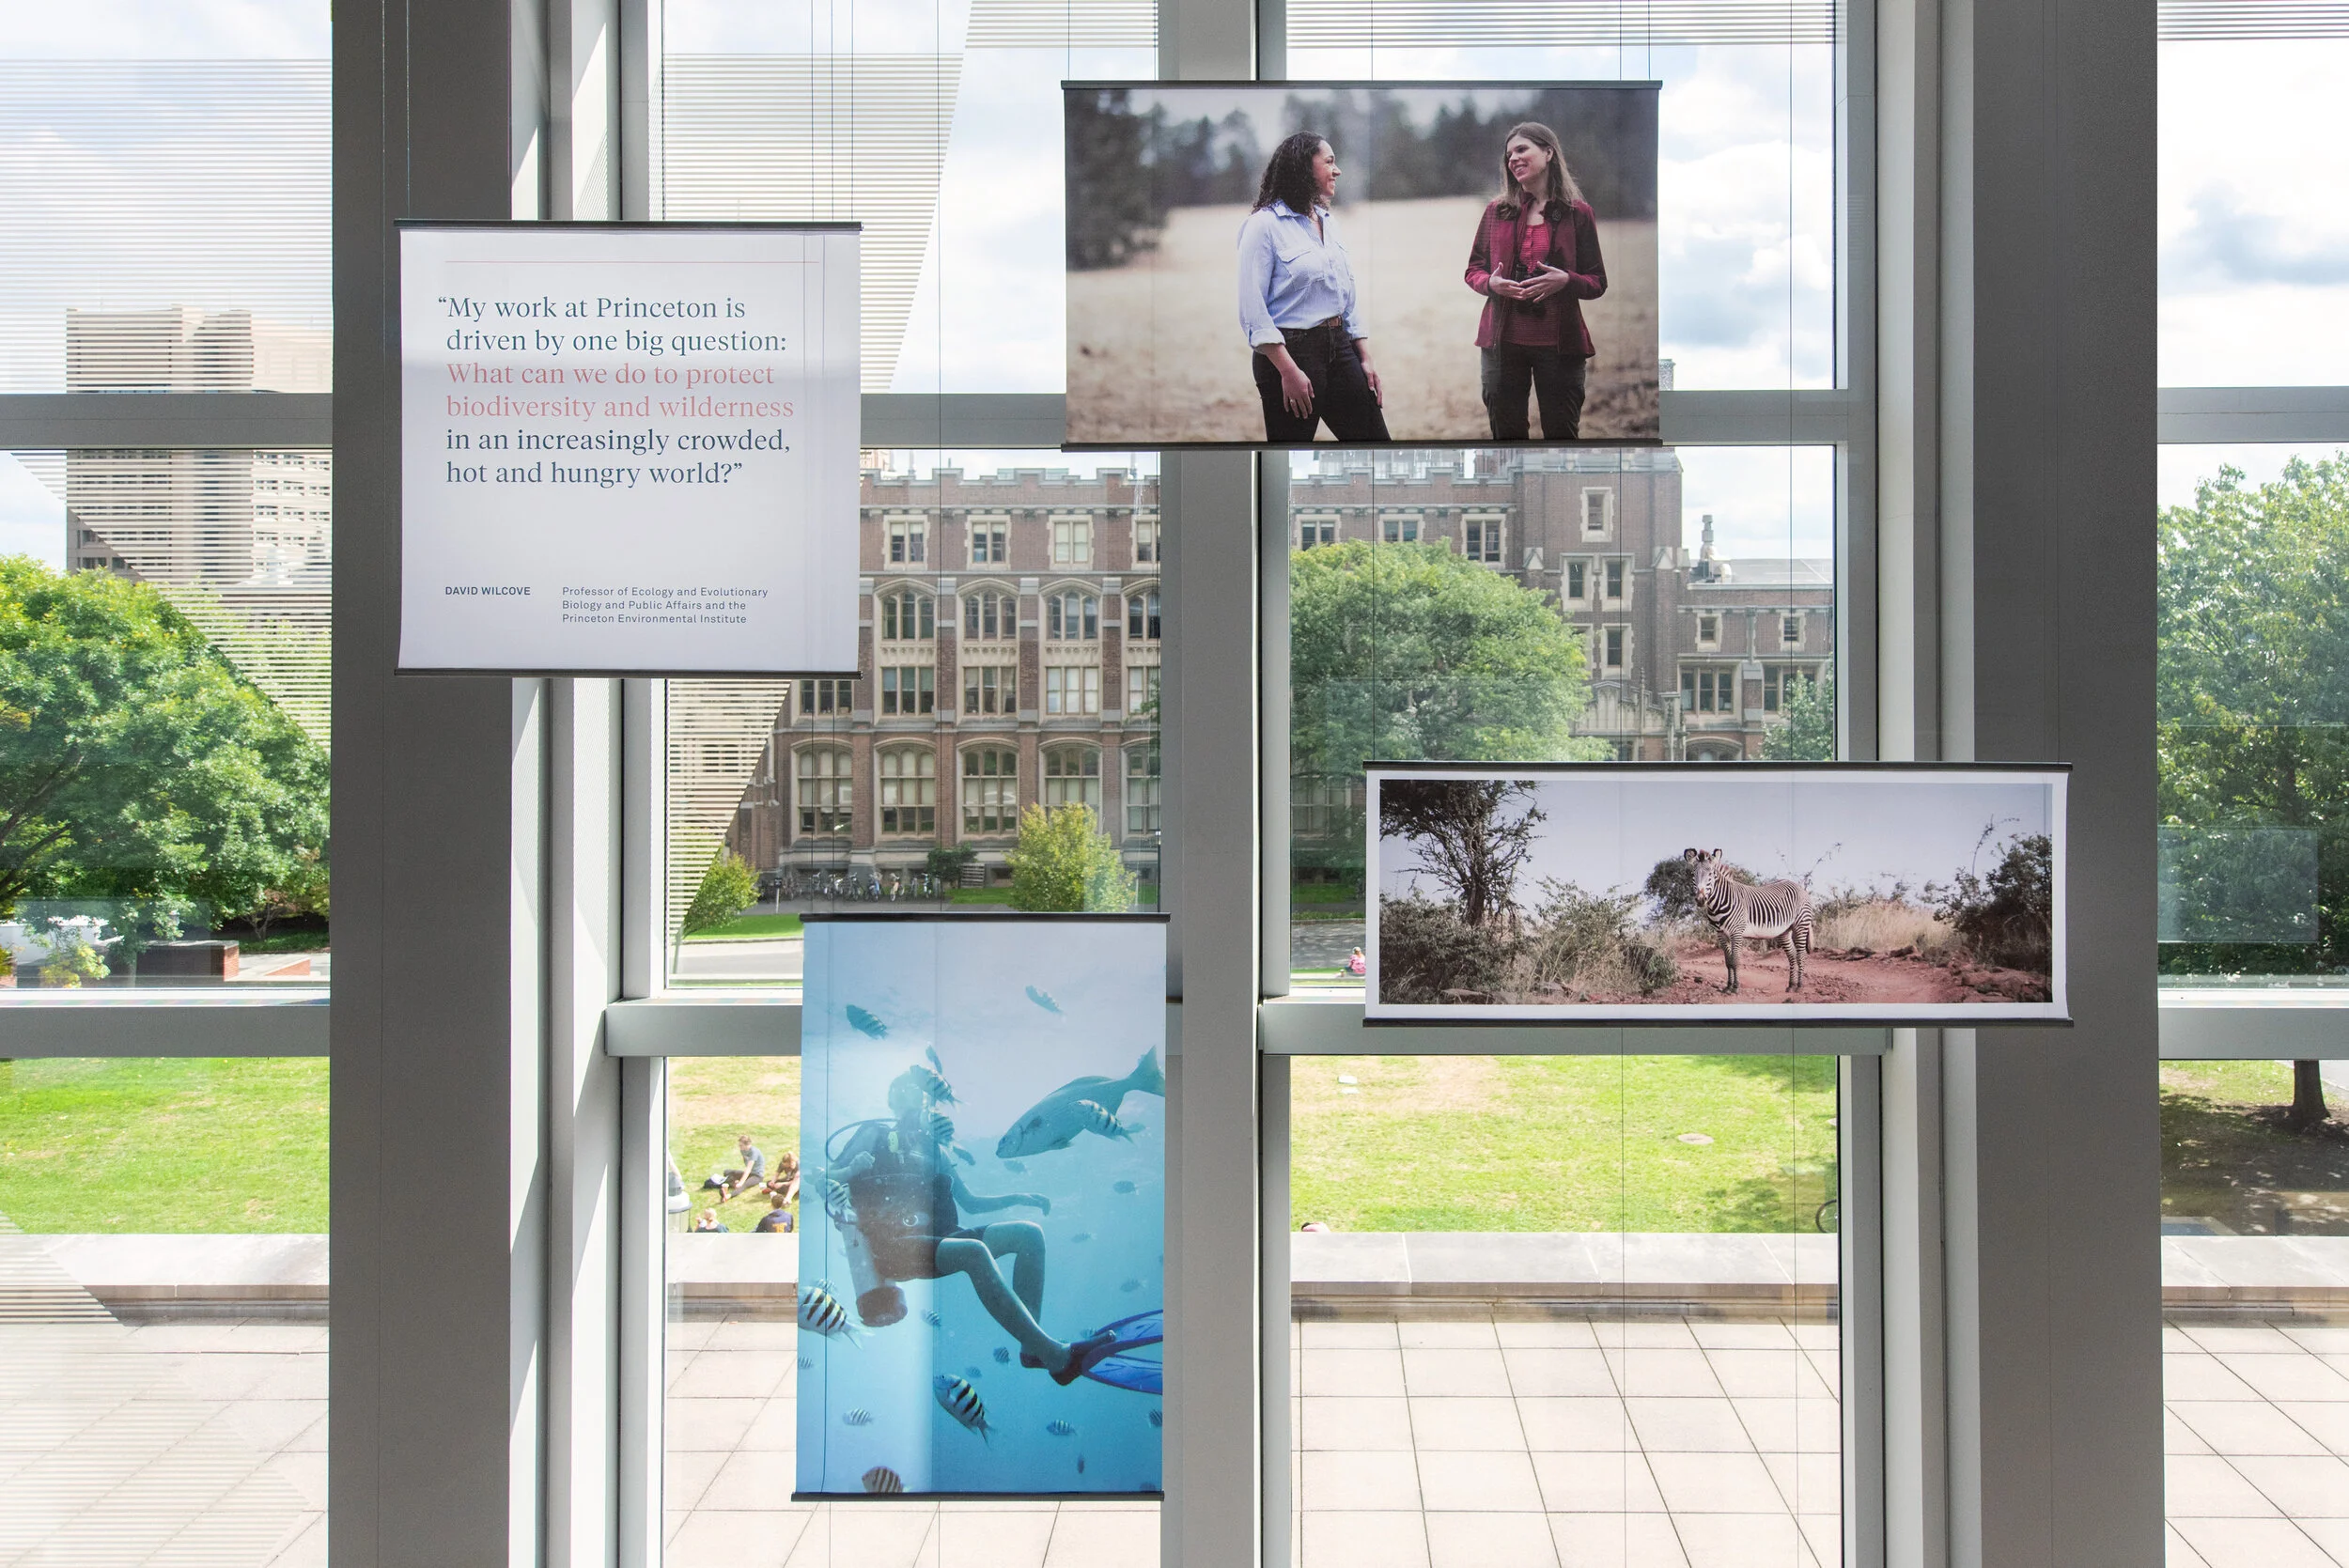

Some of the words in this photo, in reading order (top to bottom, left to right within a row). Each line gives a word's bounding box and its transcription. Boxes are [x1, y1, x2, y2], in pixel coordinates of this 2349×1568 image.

[438, 296, 487, 323] “My
[494, 295, 557, 318] work
[565, 300, 588, 318] at
[596, 296, 717, 318] Princeton
[725, 297, 745, 318] is
[446, 328, 527, 350] driven
[535, 329, 566, 356] by
[572, 334, 617, 351] one
[625, 329, 664, 357] big
[671, 330, 786, 357] question:
[446, 362, 514, 384] What
[521, 367, 566, 384] can
[572, 368, 608, 384] we
[614, 362, 646, 384] do
[654, 366, 678, 384] to
[685, 366, 775, 390] protect
[446, 395, 597, 423] biodiversity
[603, 395, 650, 417] and
[658, 395, 794, 418] wilderness
[446, 428, 471, 450] in
[478, 434, 509, 450] an
[517, 427, 670, 457] increasingly
[677, 428, 790, 453] crowded,
[446, 460, 488, 483] hot
[495, 460, 542, 483] and
[551, 460, 642, 489] hungry
[648, 461, 743, 484] world?”
[444, 586, 478, 596] DAVID
[480, 586, 531, 596] WILCOVE
[562, 586, 614, 597] Professor
[616, 586, 629, 597] of
[631, 586, 675, 598] Ecology
[677, 587, 697, 597] and
[700, 586, 769, 598] Evolutionary
[562, 599, 602, 613] Biology
[604, 600, 625, 610] and
[628, 600, 662, 610] Public
[665, 599, 703, 610] Affairs
[705, 600, 725, 611] and
[728, 600, 746, 611] the
[562, 613, 614, 624] Princeton
[617, 613, 697, 624] Environmental
[700, 613, 747, 624] Institute
